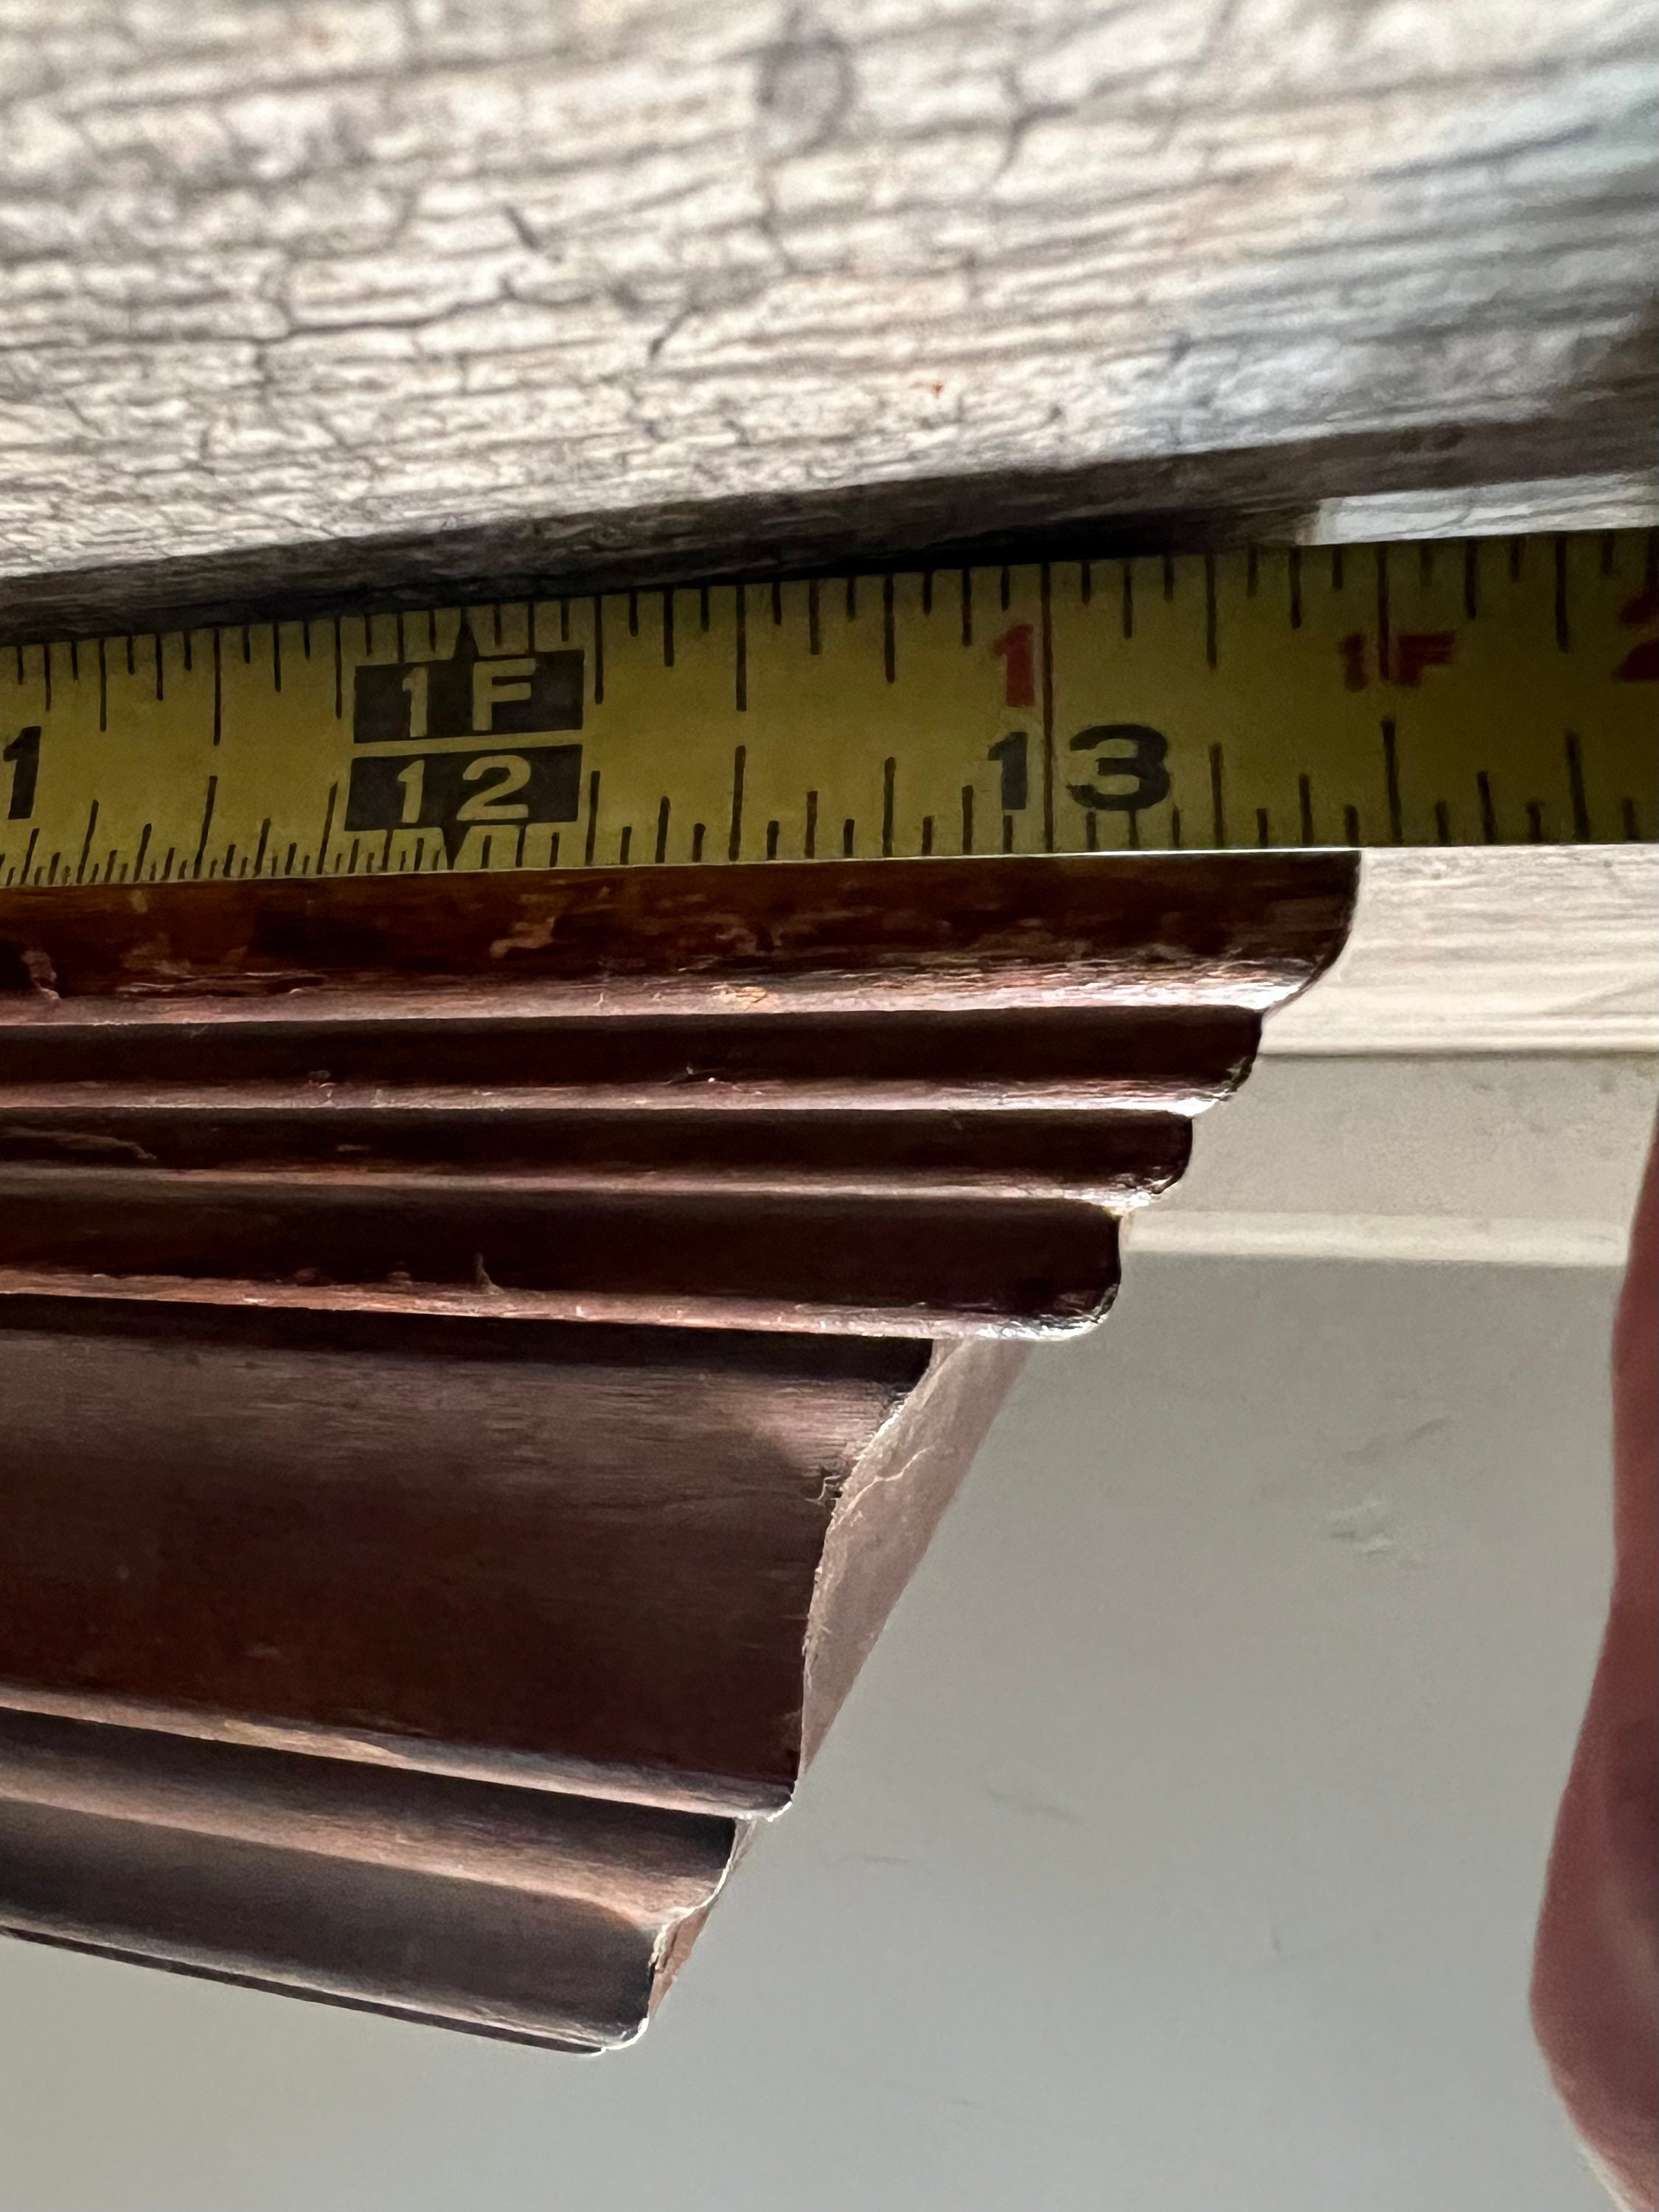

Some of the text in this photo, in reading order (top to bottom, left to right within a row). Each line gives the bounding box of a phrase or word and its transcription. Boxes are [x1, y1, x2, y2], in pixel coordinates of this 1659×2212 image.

[993, 624, 1034, 707] 1
[3, 726, 41, 819] 1
[397, 754, 532, 824] 12
[987, 723, 1171, 810] 13
